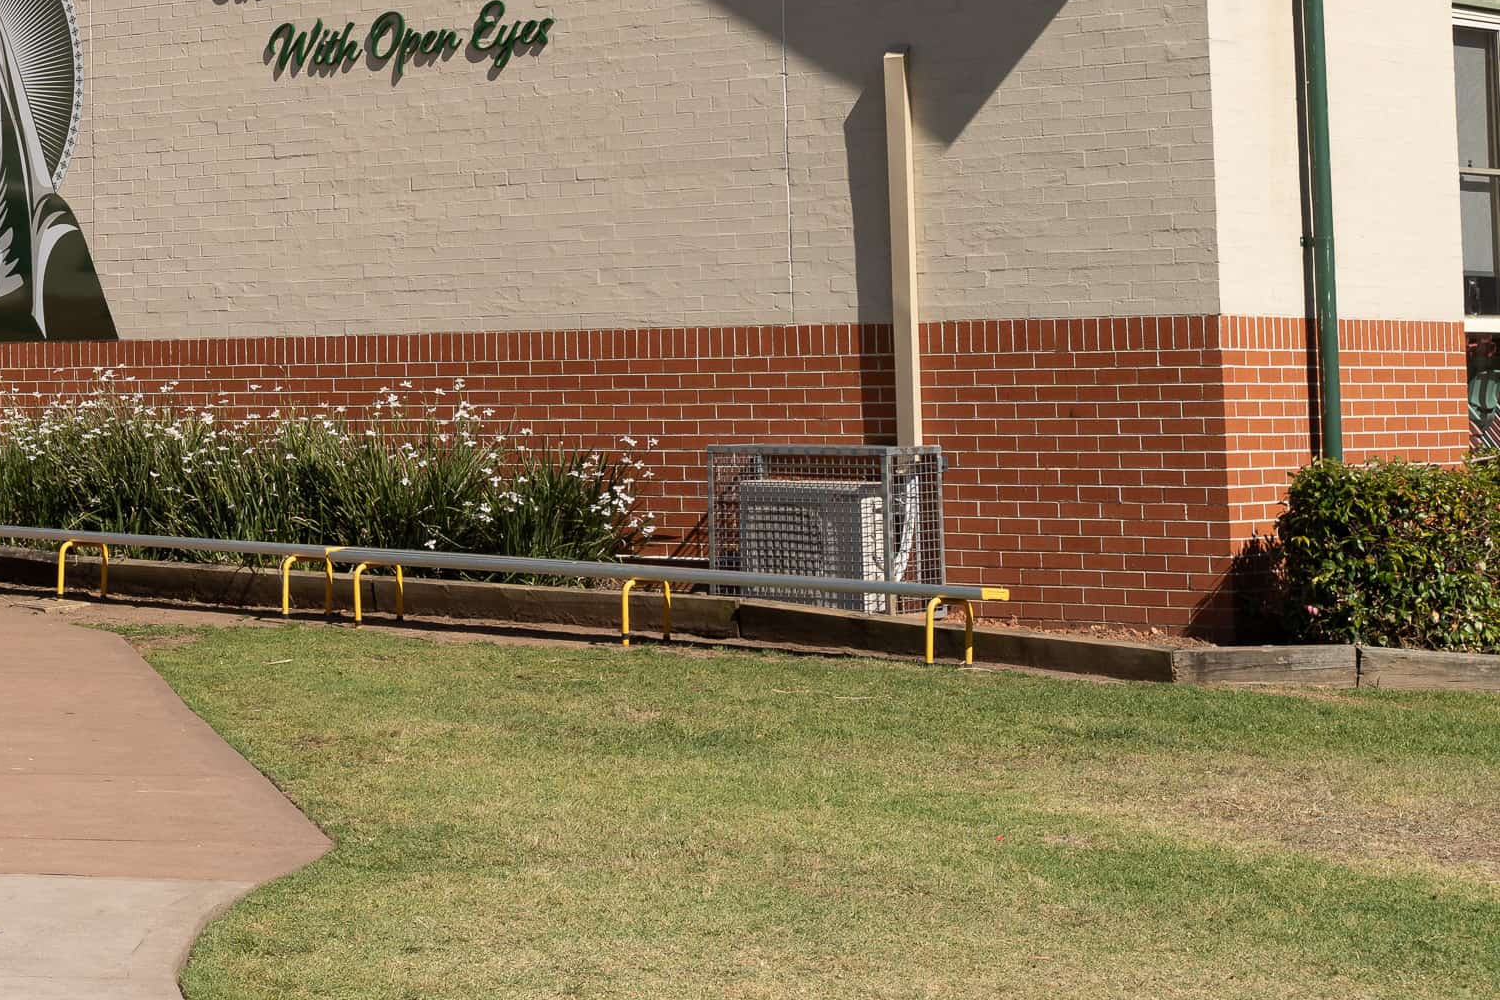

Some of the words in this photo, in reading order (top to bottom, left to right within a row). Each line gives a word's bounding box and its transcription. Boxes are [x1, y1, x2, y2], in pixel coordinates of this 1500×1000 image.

[268, 18, 363, 68] With
[370, 11, 462, 75] Open
[470, 0, 555, 67] Eyes
